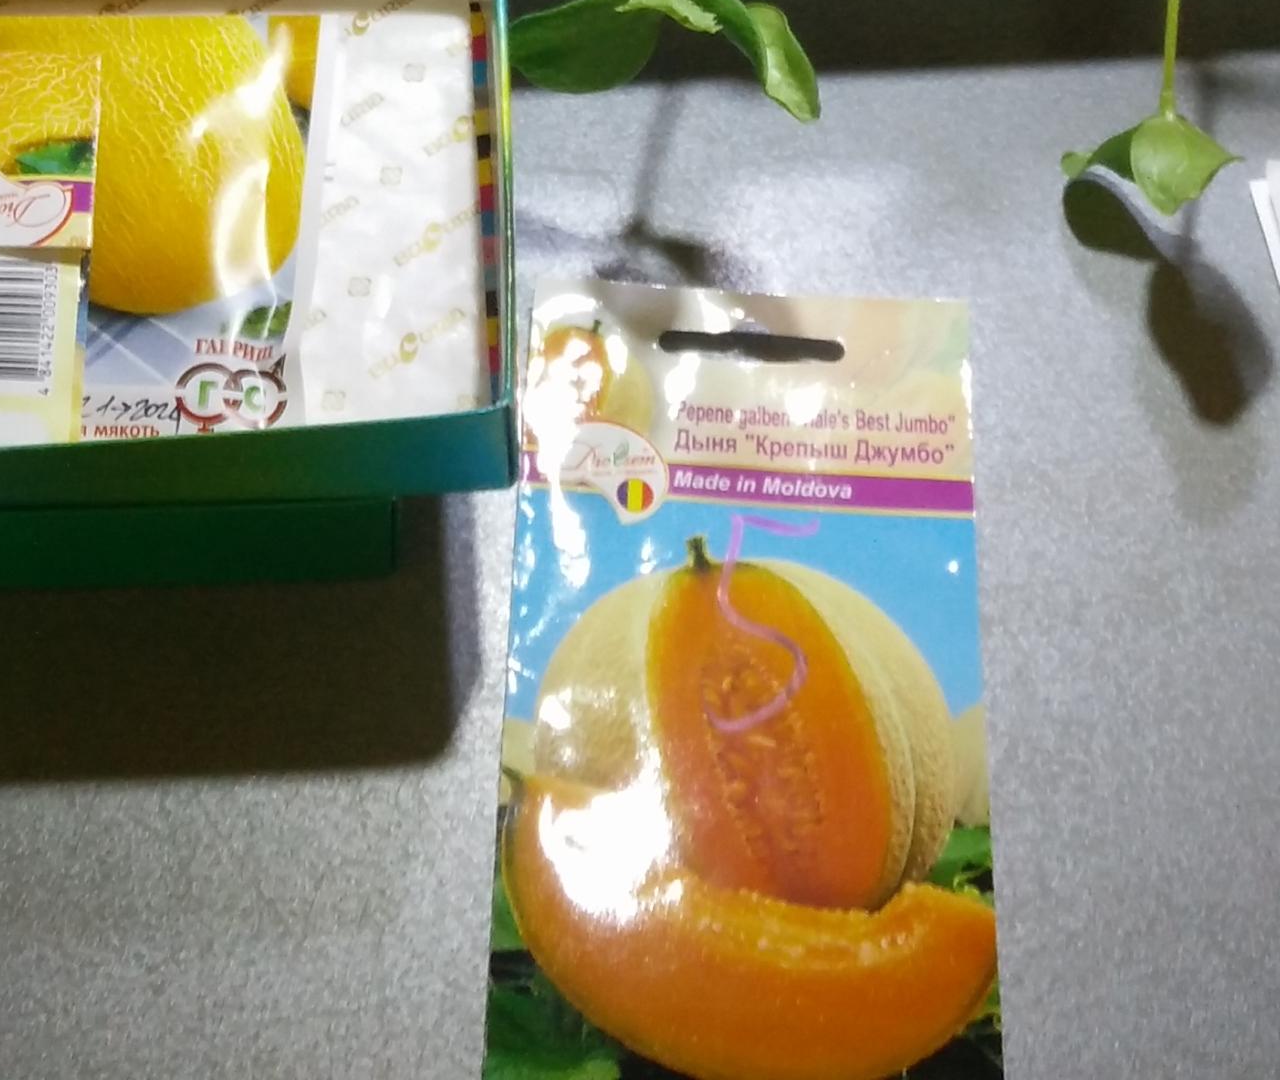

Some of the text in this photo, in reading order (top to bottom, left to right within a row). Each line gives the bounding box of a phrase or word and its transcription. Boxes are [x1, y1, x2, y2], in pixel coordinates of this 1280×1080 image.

[738, 405, 790, 430] galben
[855, 409, 892, 431] Best
[894, 413, 957, 436] Jumbo"
[673, 428, 956, 469] Дыня "Крепыш Джумбо"
[672, 466, 853, 500] Made in Moldova
